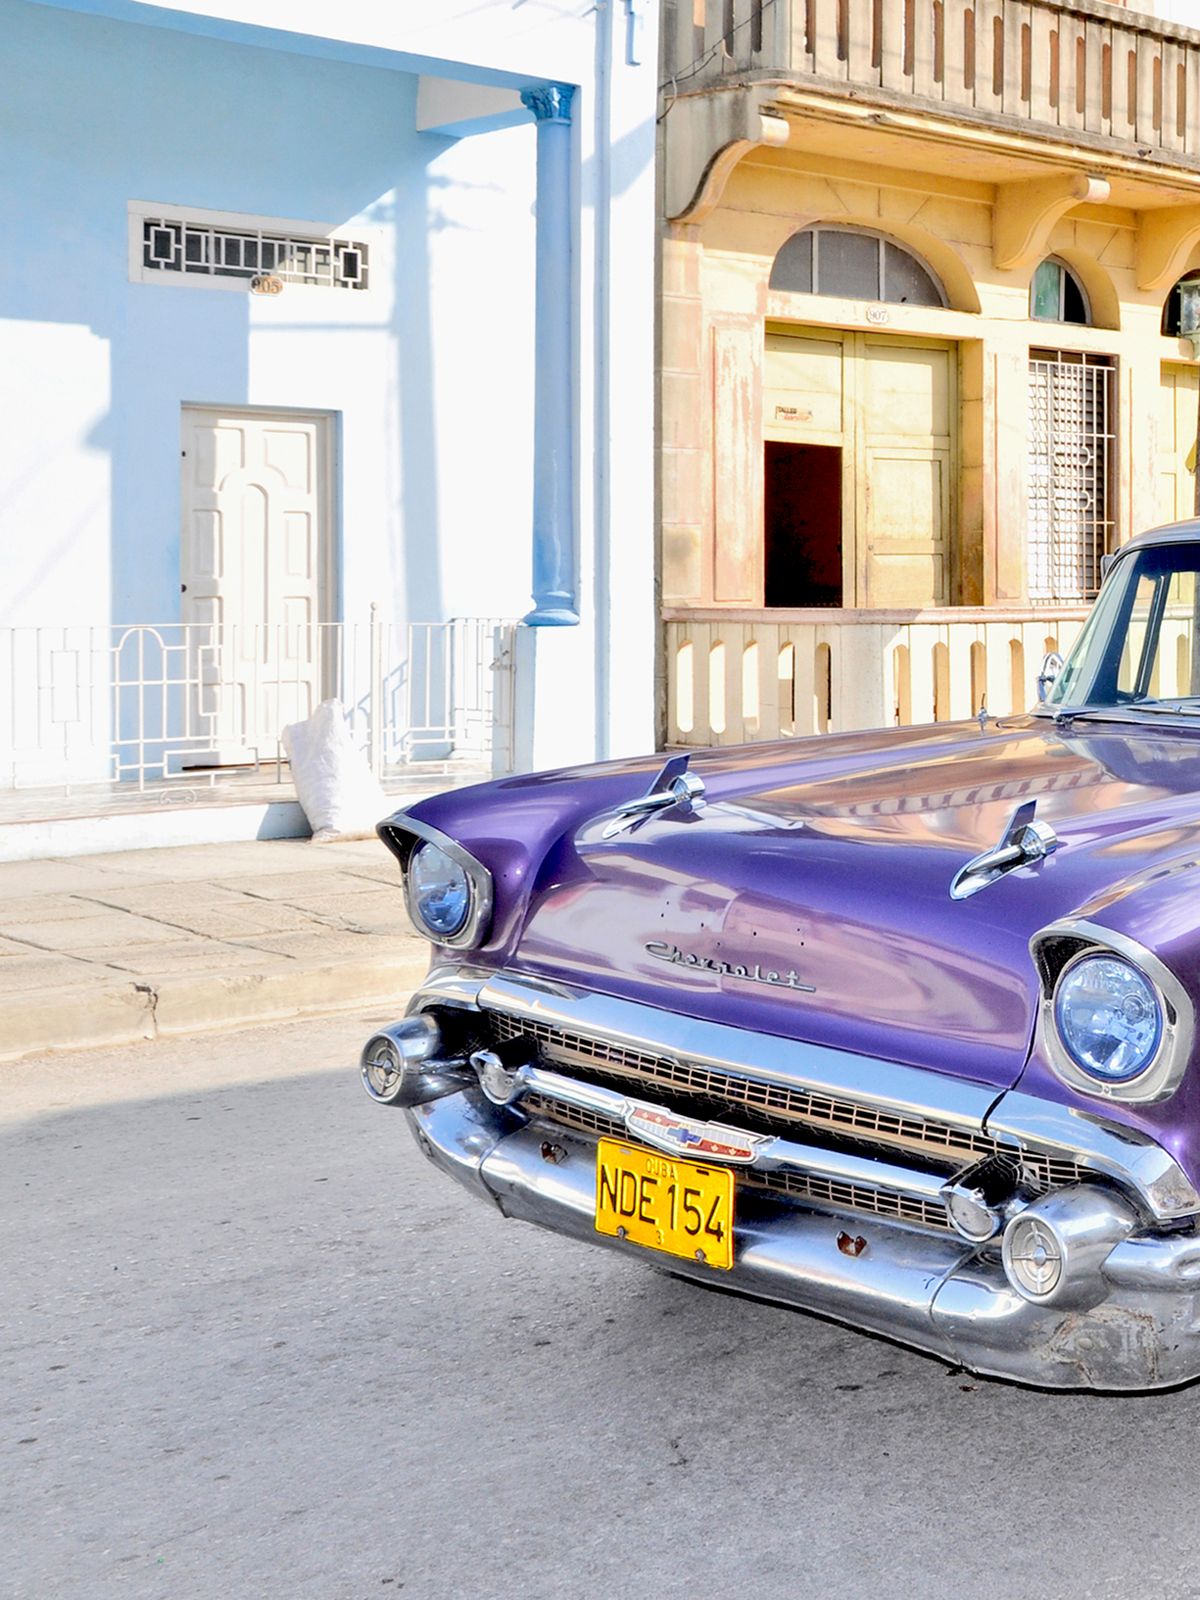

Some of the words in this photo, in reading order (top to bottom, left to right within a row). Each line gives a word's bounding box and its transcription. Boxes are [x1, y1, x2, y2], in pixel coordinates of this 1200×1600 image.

[645, 941, 816, 992] Chevrolet
[646, 1158, 676, 1180] CUBA
[600, 1164, 658, 1225] NDE
[667, 1184, 724, 1243] 154
[655, 1229, 664, 1245] 3
